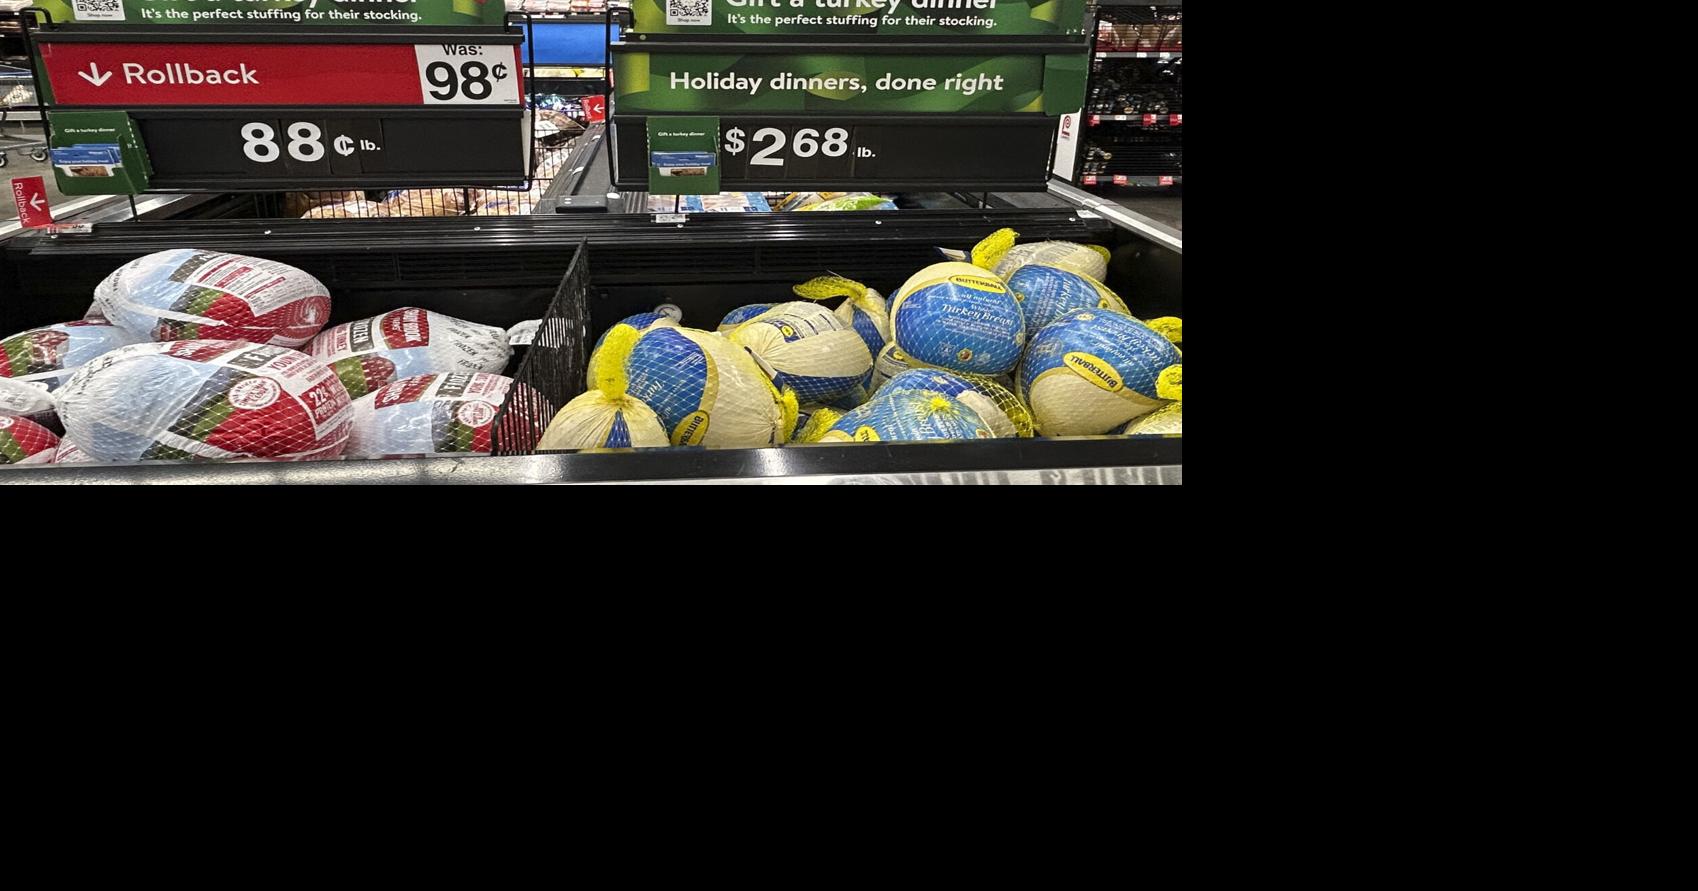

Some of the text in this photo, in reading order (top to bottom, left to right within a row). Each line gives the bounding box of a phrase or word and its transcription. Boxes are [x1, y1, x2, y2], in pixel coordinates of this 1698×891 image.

[164, 8, 189, 19] the
[192, 8, 244, 21] perfect
[247, 9, 301, 21] stuffing
[305, 9, 325, 19] for
[328, 10, 360, 19] their
[363, 10, 422, 22] stocking.
[750, 14, 772, 24] the
[775, 14, 823, 27] perfect
[826, 15, 878, 27] stuffing
[881, 15, 901, 25] for
[905, 16, 935, 26] their
[939, 16, 998, 29] stocking.
[442, 44, 483, 56] Was:
[122, 62, 260, 84] Rollback
[670, 72, 1004, 95] Holiday dinners, done right
[360, 139, 381, 151] lb.
[857, 147, 876, 158] lb.
[13, 182, 31, 224] Rollback
[942, 303, 1013, 326] Turkey Breast
[1070, 355, 1118, 388] BUTTERBALL
